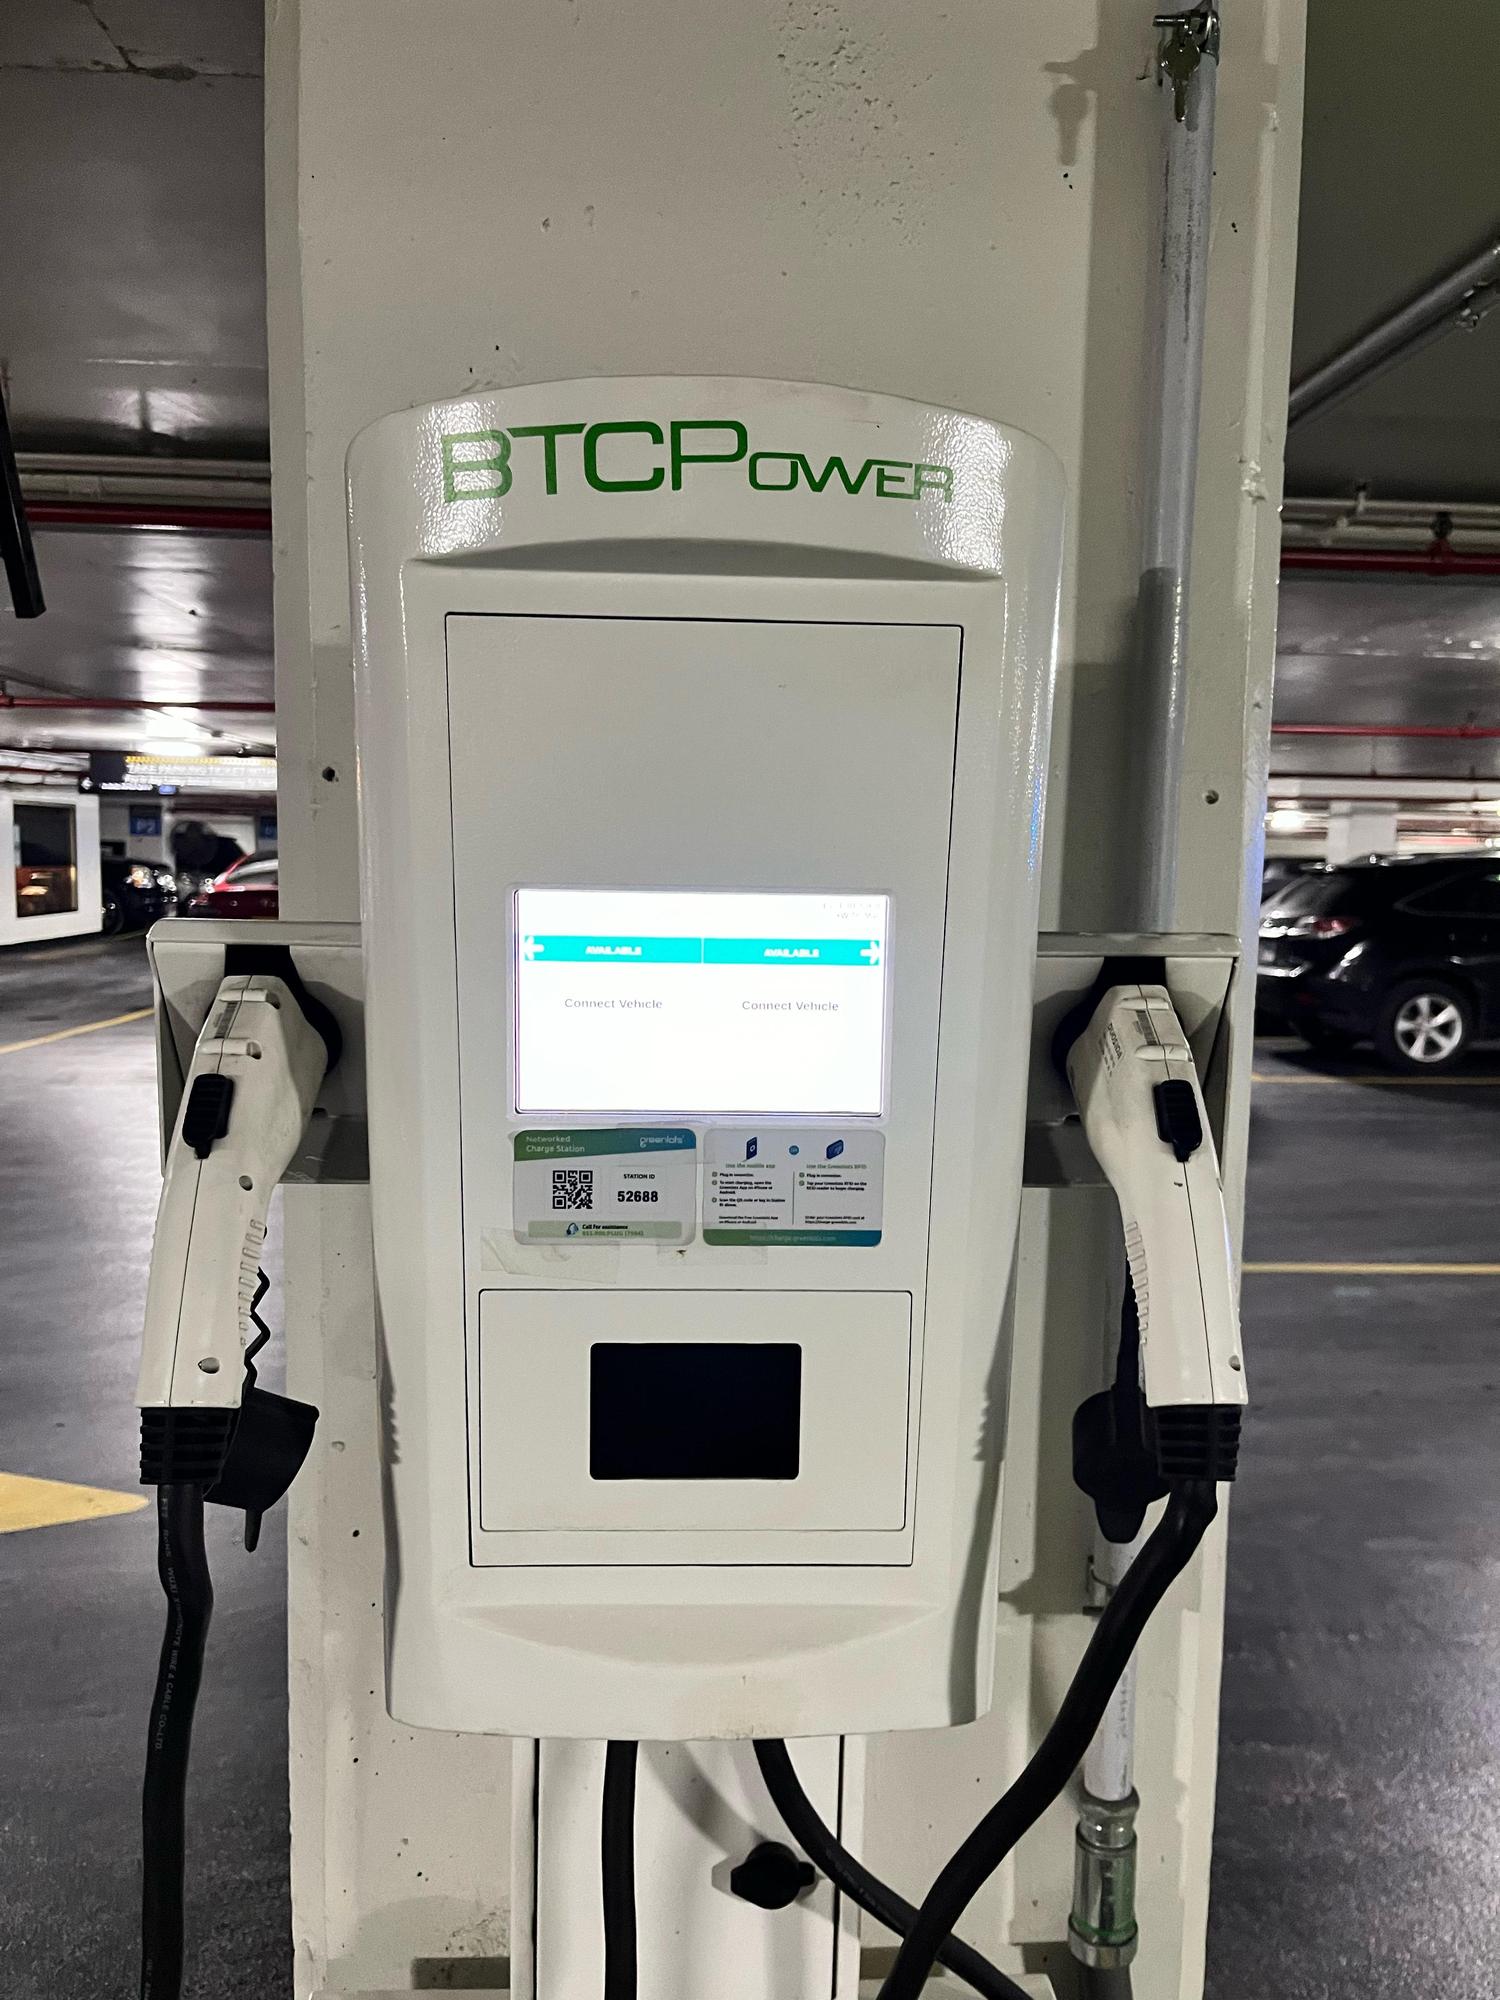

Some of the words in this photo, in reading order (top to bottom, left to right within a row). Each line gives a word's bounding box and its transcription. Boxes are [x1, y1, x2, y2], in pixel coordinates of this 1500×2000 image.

[585, 946, 642, 956] AVAILABLE
[763, 948, 820, 958] AVAILABLE
[564, 998, 616, 1010] Connect
[619, 998, 663, 1010] Vehicle
[742, 1000, 792, 1012] Connect
[796, 1000, 839, 1012] Vehicle
[526, 1135, 571, 1143] Networked
[526, 1145, 556, 1154] Charge
[617, 1190, 659, 1203] 52688
[169, 1650, 178, 1671] WIRE
[162, 1682, 173, 1710] CABLE
